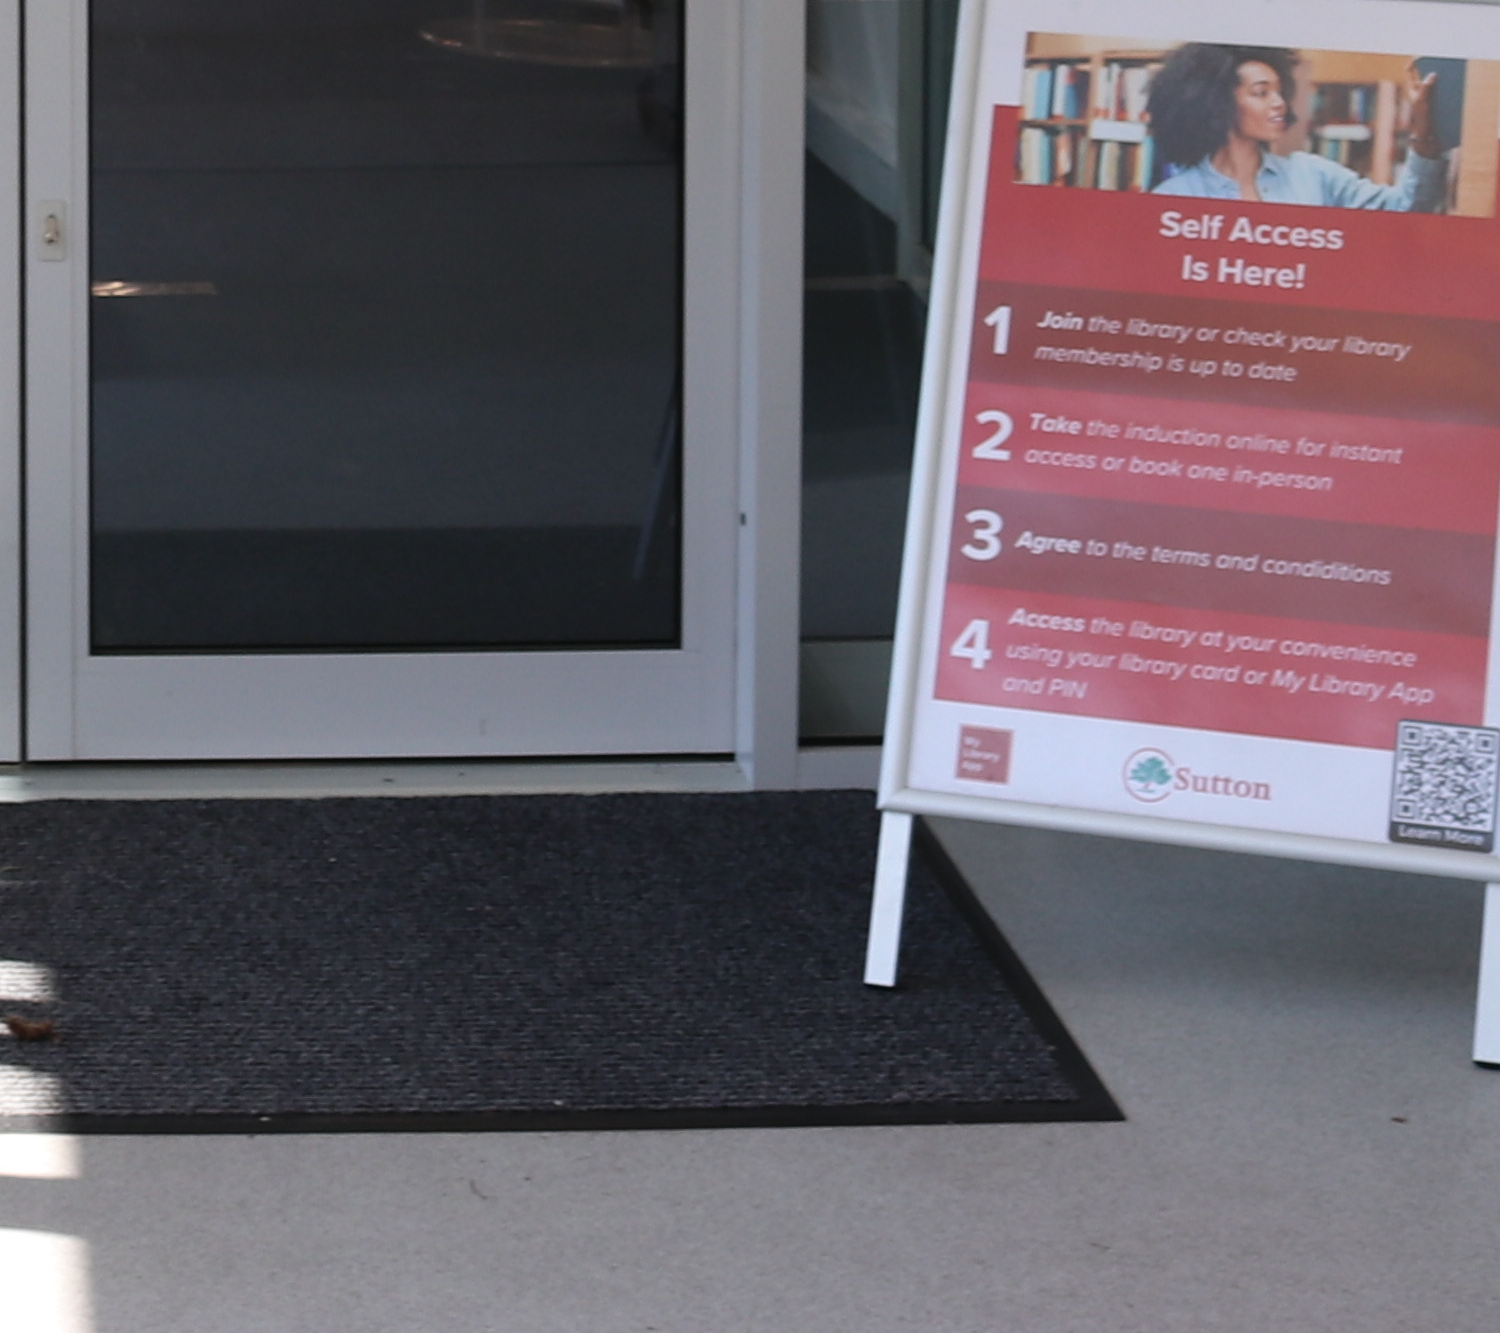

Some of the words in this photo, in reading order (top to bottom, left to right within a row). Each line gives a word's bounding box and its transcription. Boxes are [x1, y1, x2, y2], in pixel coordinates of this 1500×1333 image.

[1159, 210, 1223, 240] Self
[1228, 216, 1344, 250] Access
[1182, 254, 1208, 282] Is
[1218, 258, 1306, 289] Here!
[984, 305, 1012, 355] 1
[1037, 310, 1083, 331] Join
[1087, 314, 1121, 335] the
[1125, 317, 1193, 345] library
[1195, 326, 1219, 342] or
[1223, 327, 1286, 349] check
[1290, 335, 1340, 354] your
[1342, 335, 1412, 362] library
[1034, 343, 1163, 373] membership
[1166, 353, 1185, 372] is
[1189, 358, 1219, 377] up
[1222, 357, 1244, 377] to
[1247, 360, 1298, 382] date
[972, 409, 1014, 461] 2
[1030, 413, 1083, 435] Take
[1086, 420, 1124, 439] the
[1125, 422, 1221, 448] induction
[1225, 433, 1291, 455] online
[1296, 436, 1327, 457] for
[1330, 441, 1403, 464] instant
[1024, 448, 1096, 467] access
[1102, 456, 1126, 471] or
[1128, 456, 1183, 477] book
[1187, 463, 1229, 482] one
[1233, 465, 1333, 491] in-person
[961, 509, 1004, 561] 3
[1015, 530, 1081, 554] Agree
[1085, 538, 1107, 557] to
[1112, 541, 1146, 561] the
[1151, 545, 1211, 567] terms
[1214, 553, 1259, 572] and
[950, 617, 993, 670] 4
[1008, 607, 1085, 633] Access
[1090, 617, 1125, 637] the
[1128, 620, 1199, 649] library
[1200, 630, 1224, 647] at
[1224, 634, 1277, 653] your
[1279, 638, 1418, 668] convenience
[1002, 675, 1045, 694] and
[1048, 678, 1088, 699] PIN
[1006, 642, 1063, 668] using
[1066, 650, 1117, 670] your
[1118, 653, 1187, 681] library
[1190, 662, 1241, 682] card
[1243, 669, 1268, 685] or
[1270, 669, 1305, 694] My
[1308, 673, 1385, 702] Library
[1388, 681, 1435, 705] App
[1173, 767, 1272, 801] Sutton
[1444, 829, 1485, 846] More
